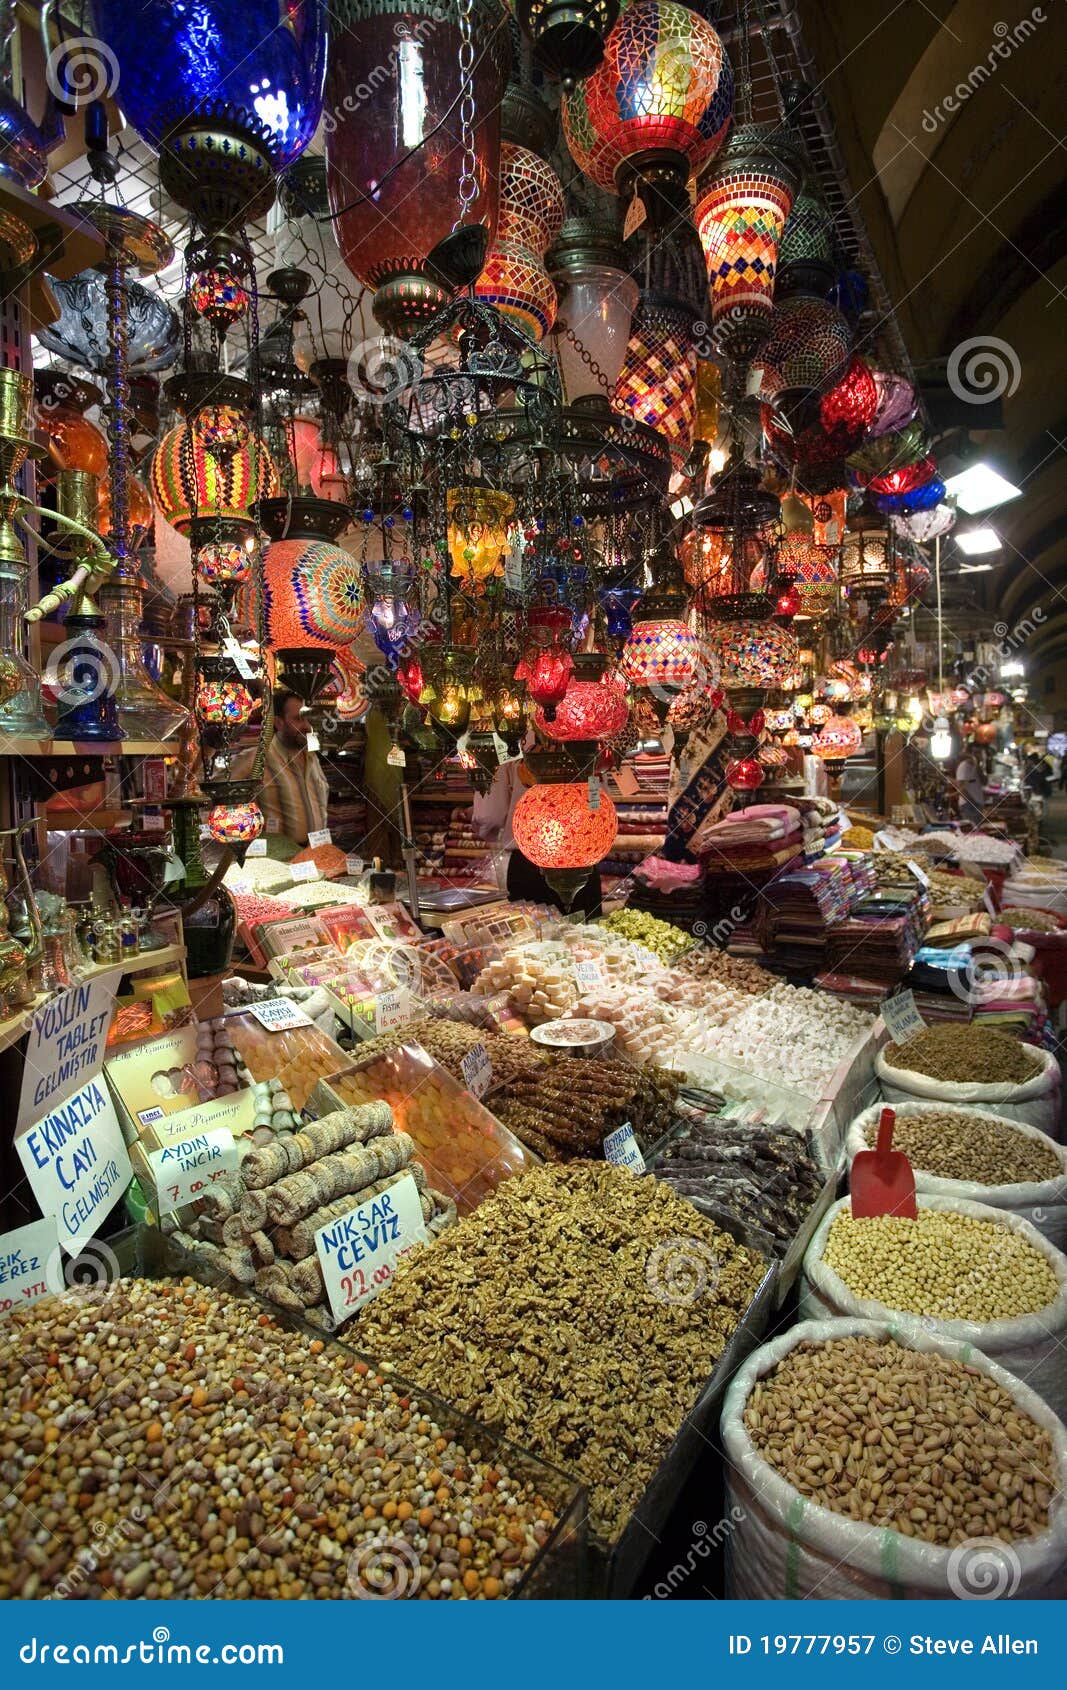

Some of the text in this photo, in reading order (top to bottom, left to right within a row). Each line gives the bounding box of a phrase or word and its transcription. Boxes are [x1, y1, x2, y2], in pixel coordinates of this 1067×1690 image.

[57, 1011, 108, 1060] TABLET
[26, 1083, 106, 1168] EKİNAZYA
[161, 1135, 209, 1163] AYDIN
[55, 1137, 97, 1192] ÇAYI
[177, 1145, 222, 1172] İNCİR
[62, 1160, 120, 1235] GELMİŞTİR
[321, 1193, 394, 1254] NİKSAR
[337, 1214, 401, 1271] CEVİZ
